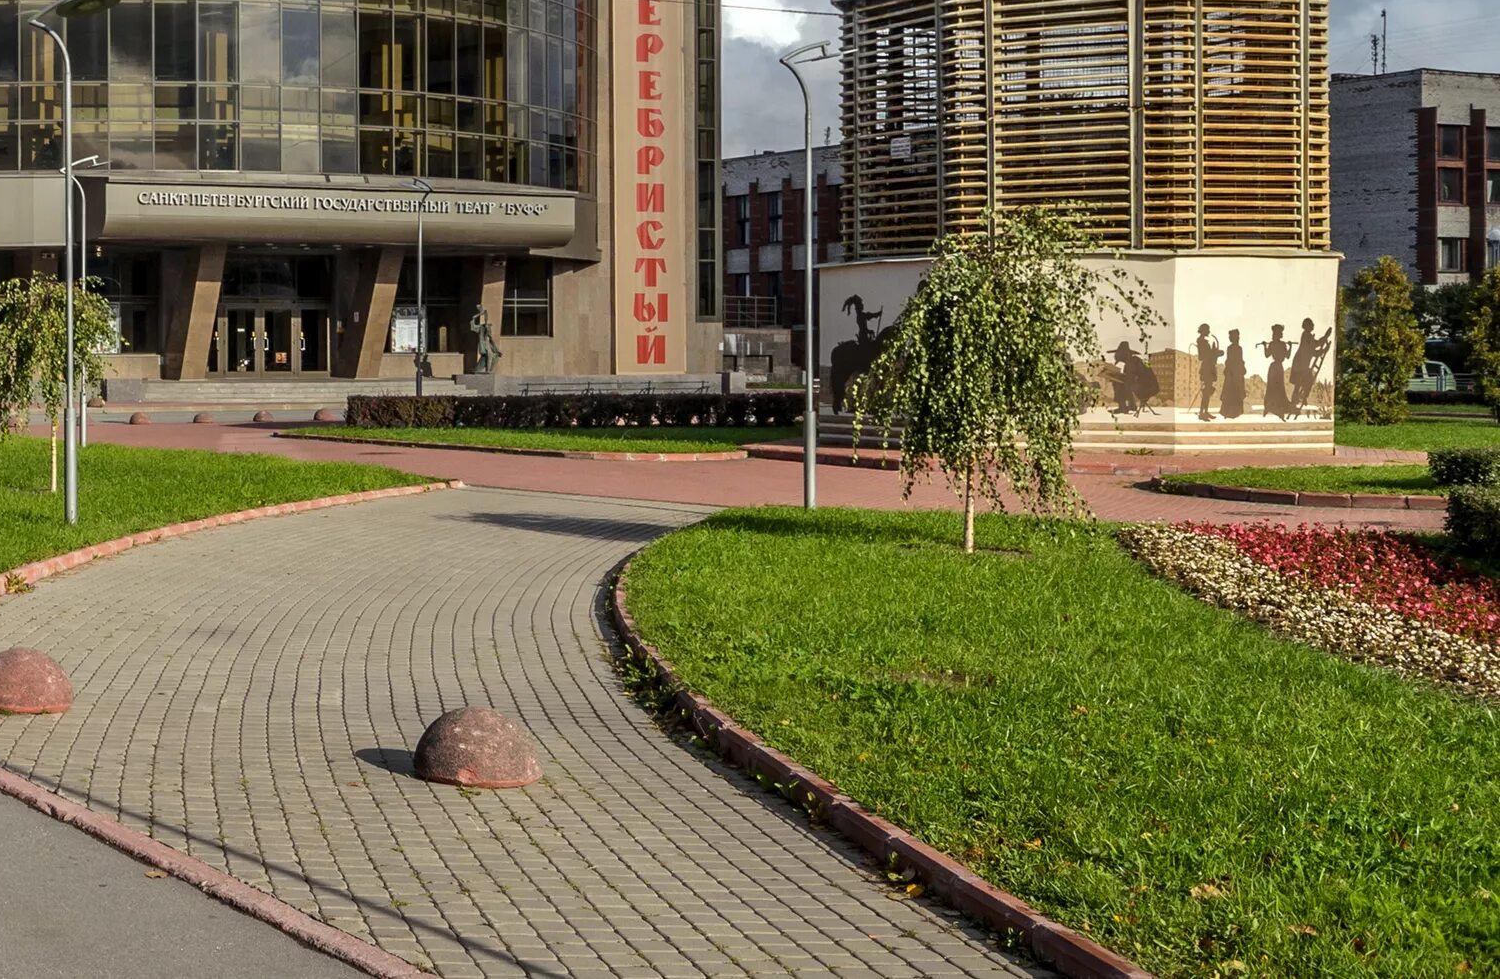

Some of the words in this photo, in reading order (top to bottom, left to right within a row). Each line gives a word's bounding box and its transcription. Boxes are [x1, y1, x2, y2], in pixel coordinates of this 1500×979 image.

[138, 190, 309, 209] САНКТ-ПЕТЕРБУРГСКИЙ
[314, 196, 450, 214] ГОСУДАРСТВЕННЫЙ
[455, 201, 496, 215] ТЕАТР
